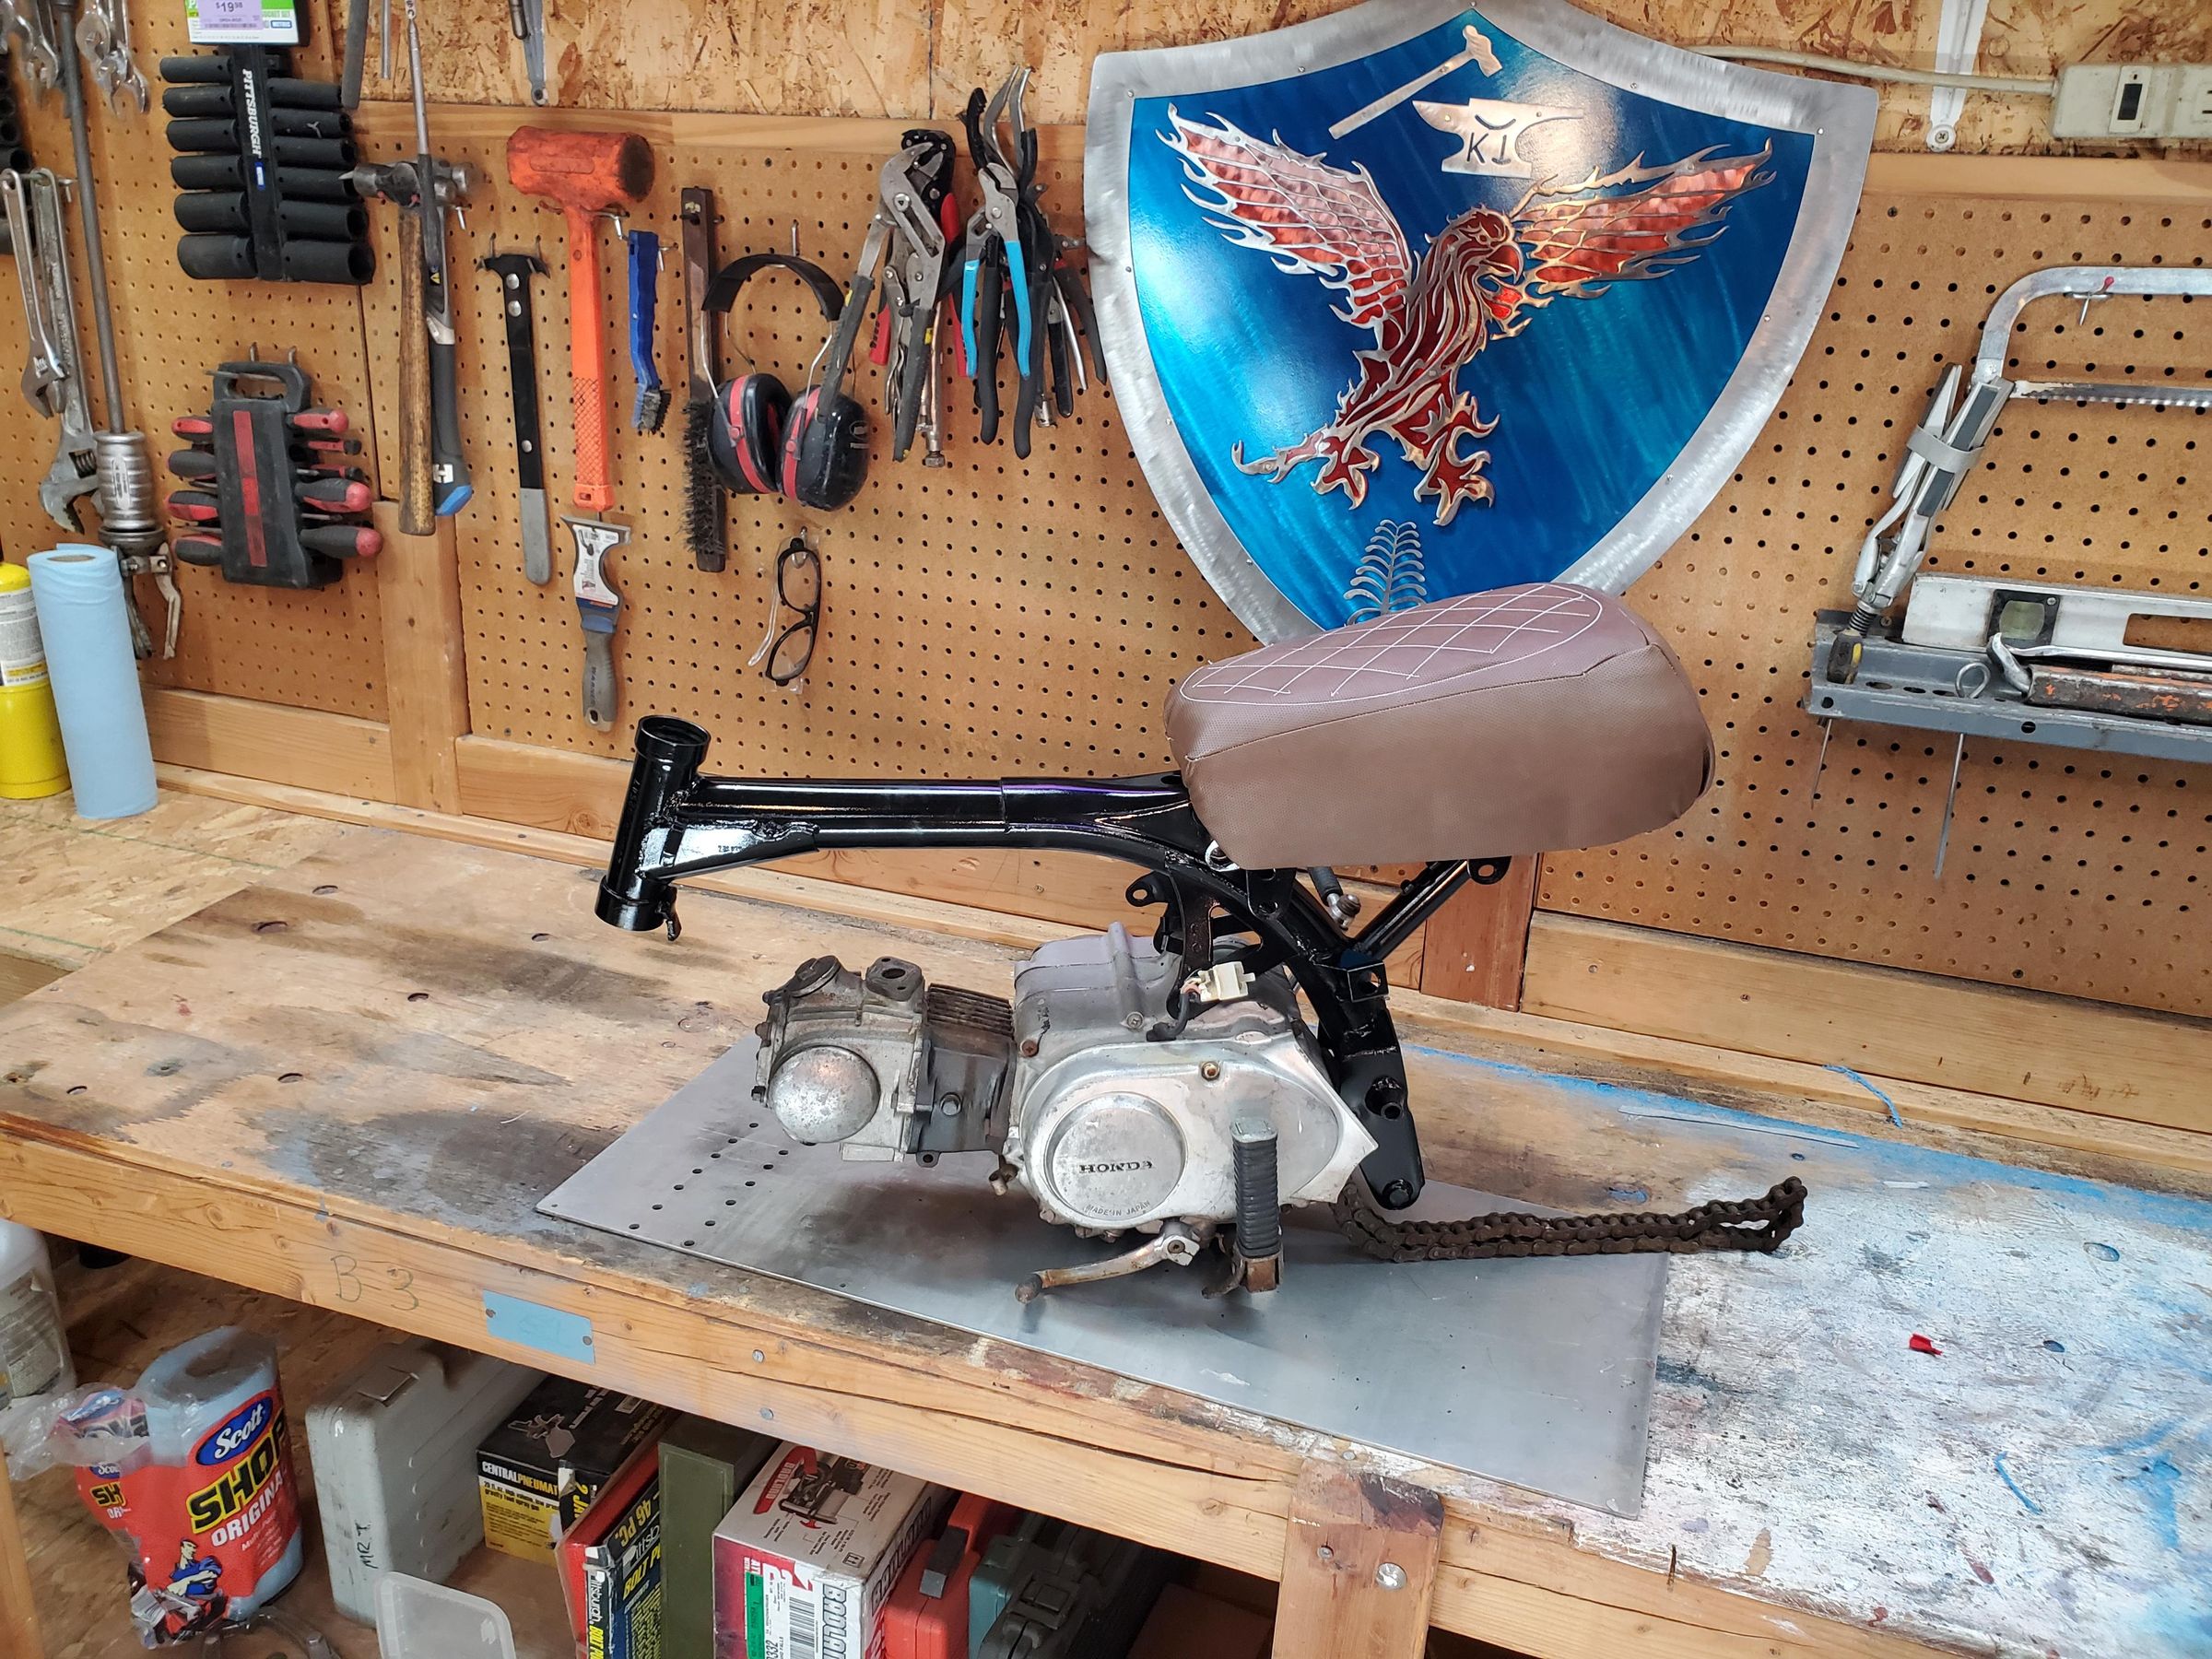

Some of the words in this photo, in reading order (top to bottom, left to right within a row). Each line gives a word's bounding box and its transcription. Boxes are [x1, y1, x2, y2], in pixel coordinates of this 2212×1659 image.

[242, 69, 262, 158] PITTSBURGH
[1079, 1160, 1153, 1174] HONDA
[1126, 1200, 1151, 1216] JAPAN
[214, 1404, 264, 1459] Scott
[89, 1481, 126, 1507] SH
[822, 1583, 847, 1659] BADLA
